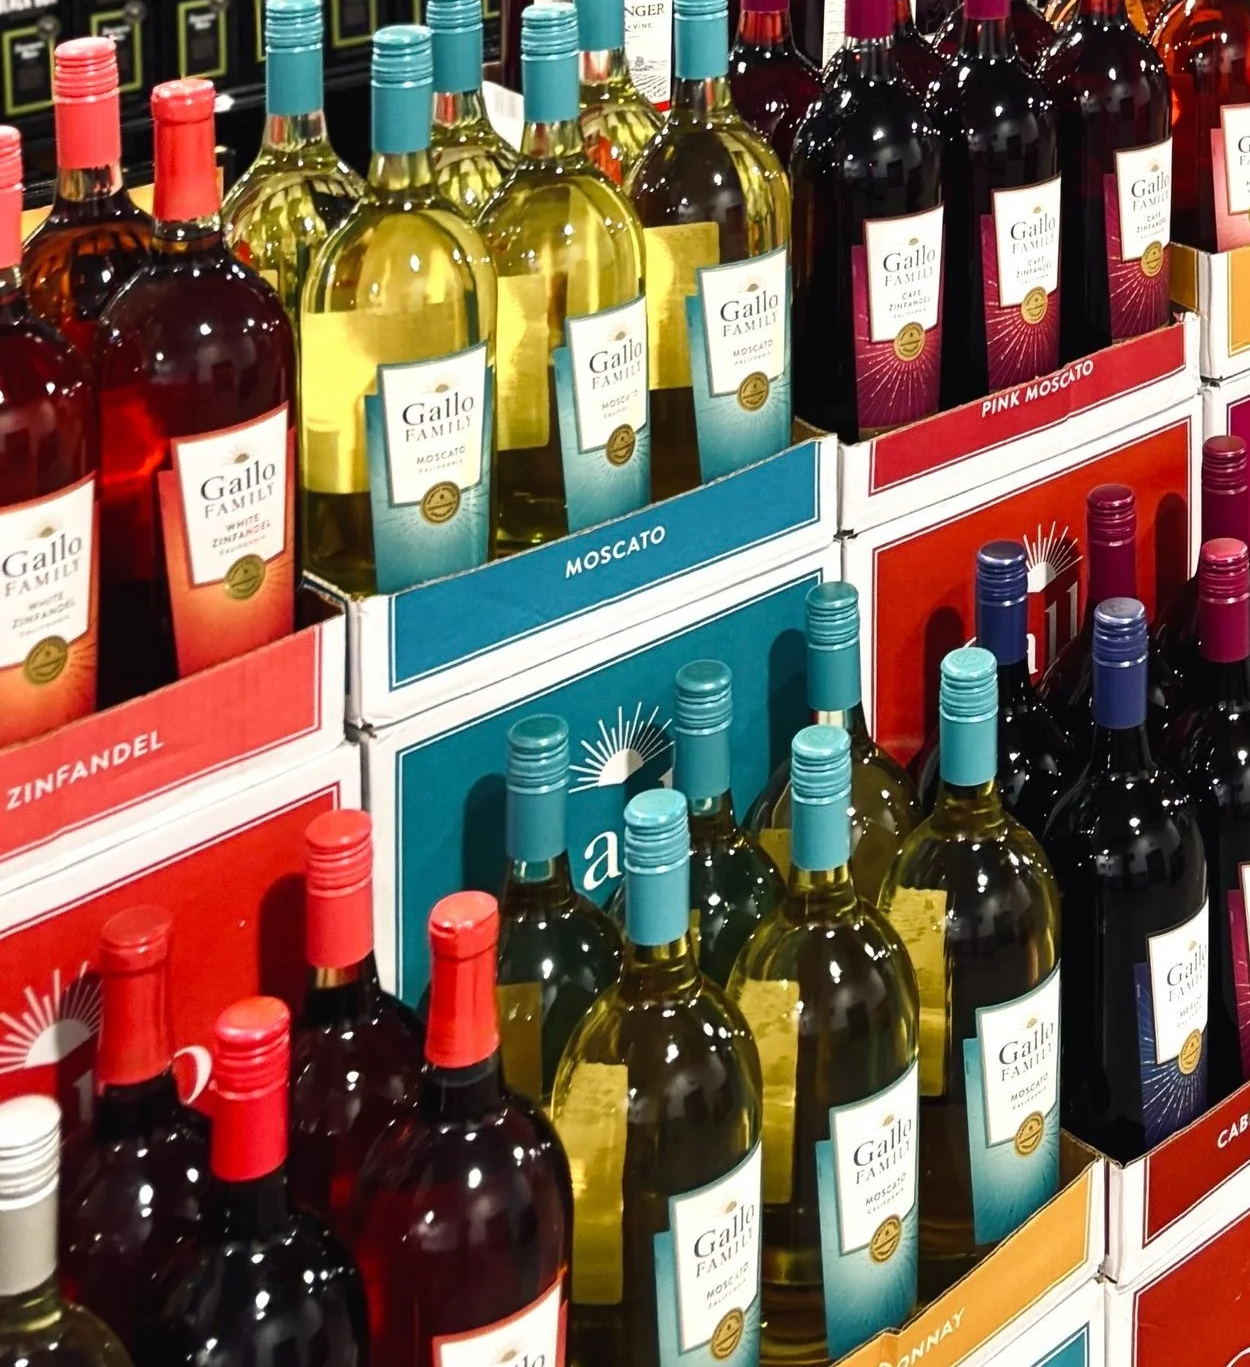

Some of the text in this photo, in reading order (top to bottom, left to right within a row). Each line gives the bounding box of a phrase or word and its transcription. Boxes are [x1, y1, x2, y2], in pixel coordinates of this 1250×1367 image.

[1131, 170, 1170, 200] Gallo
[1010, 213, 1056, 242] Gallo
[883, 245, 935, 274] Gallo
[719, 290, 779, 323] Gallo
[722, 310, 779, 338] FAMILY
[589, 339, 643, 375] Gallo
[732, 339, 773, 358] MOSCATO
[591, 361, 642, 390] FAMILY
[981, 359, 1094, 418] PINK MOSCATO
[402, 392, 475, 427] Gallo
[405, 413, 472, 444] FAMILY
[416, 444, 466, 466] MOSCATO
[200, 460, 276, 502] Gallo
[204, 482, 275, 520] FAMILY
[211, 519, 271, 549] ZINFANDEL
[225, 513, 259, 533] WHITE
[1, 533, 83, 579] Gallo
[564, 525, 666, 579] MOSCATO
[4, 559, 81, 599] FAMILY
[11, 598, 76, 630] ZINFANDEL
[28, 590, 64, 611] WHITE
[6, 729, 165, 812] ZINFANDEL
[998, 1021, 1054, 1067] Gallo
[1000, 1041, 1054, 1083] FAMILY
[1010, 1072, 1049, 1102] MOSCATO
[852, 1115, 912, 1169] Gallo
[855, 1142, 911, 1186] FAMILY
[865, 1172, 907, 1206] MOSCATO
[693, 1200, 755, 1260] Gallo
[695, 1228, 754, 1278] FAMILY
[705, 1261, 749, 1301] MOSCATO
